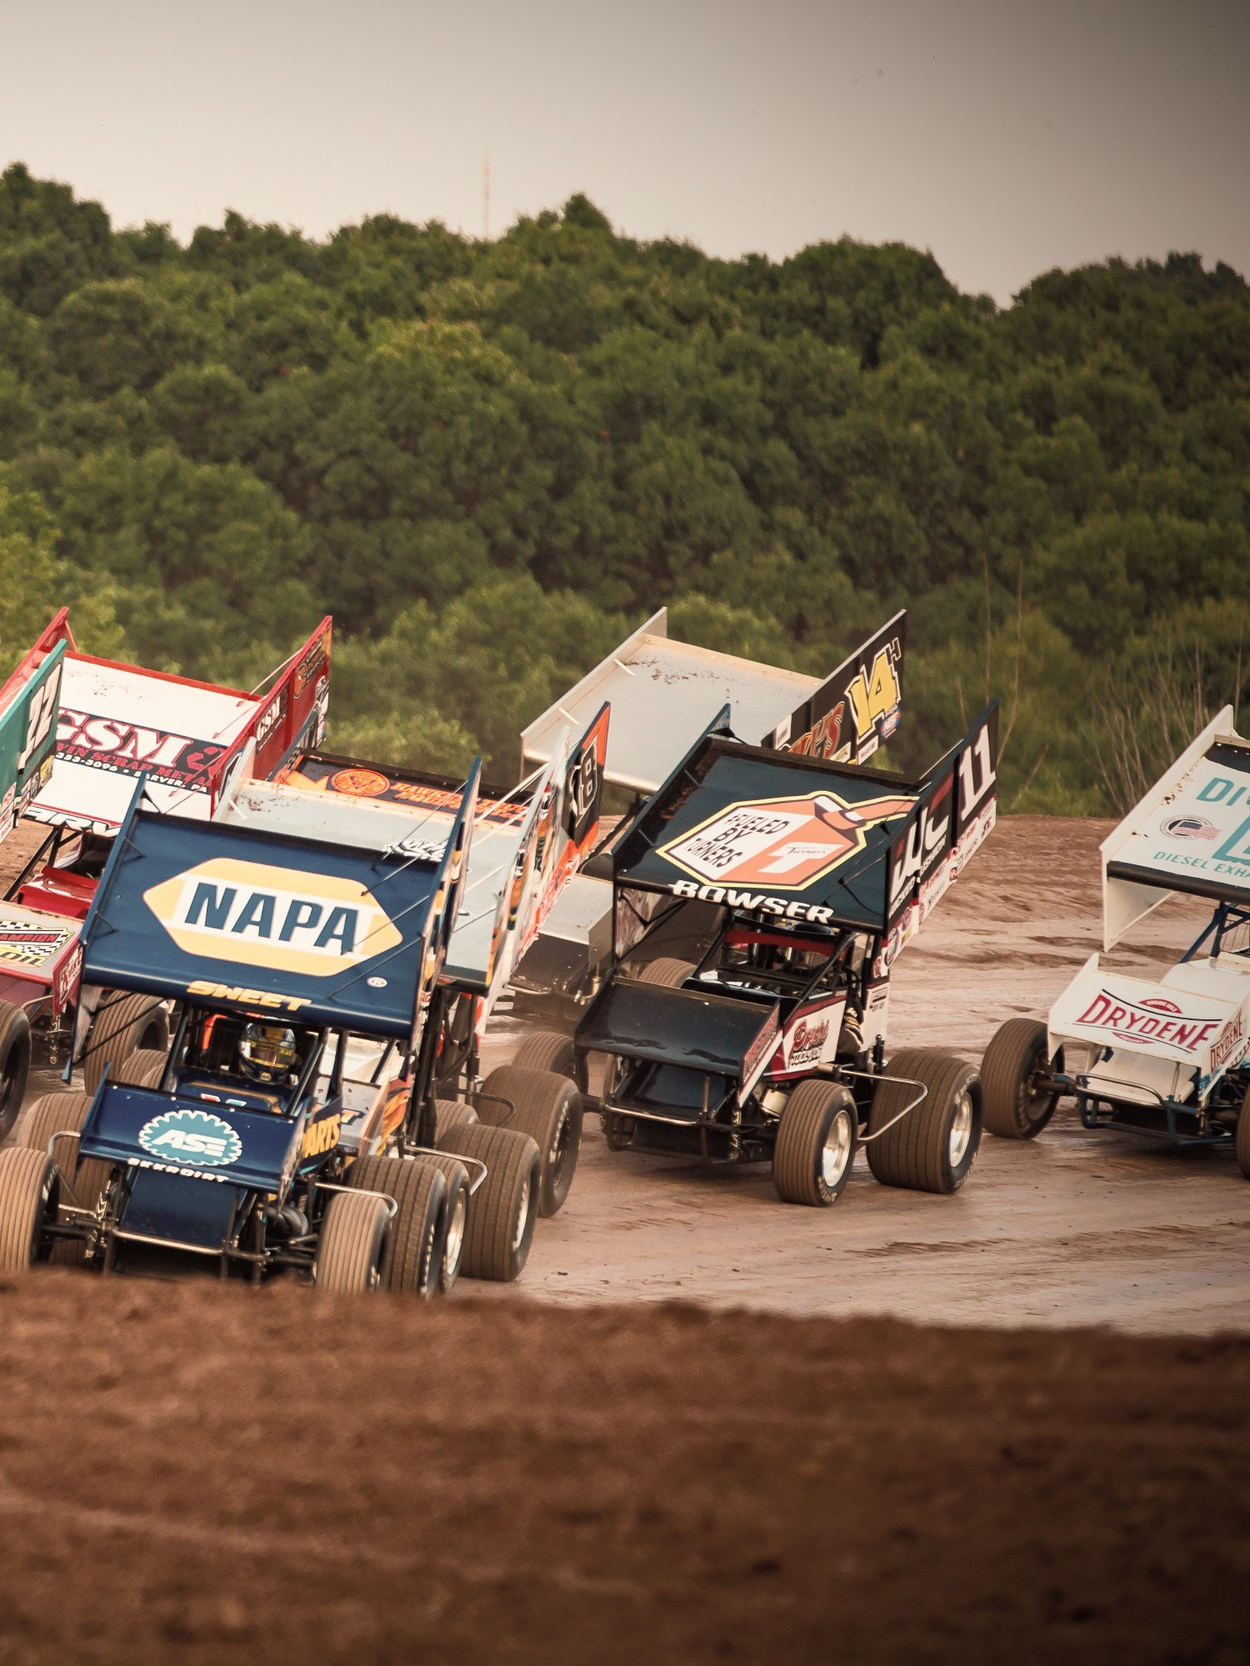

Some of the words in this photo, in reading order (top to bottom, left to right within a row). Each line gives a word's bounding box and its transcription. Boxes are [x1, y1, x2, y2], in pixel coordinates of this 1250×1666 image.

[1196, 777, 1250, 811] DI
[713, 828, 753, 845] BY
[683, 838, 743, 868] TURNERS
[1153, 851, 1210, 869] DIESEL
[668, 879, 834, 924] BOWSER
[184, 882, 360, 956] NAPA
[0, 951, 43, 966] OIL
[186, 979, 312, 1012] SWEET
[1076, 993, 1220, 1051] DRYDENE
[152, 1129, 228, 1157] ASE
